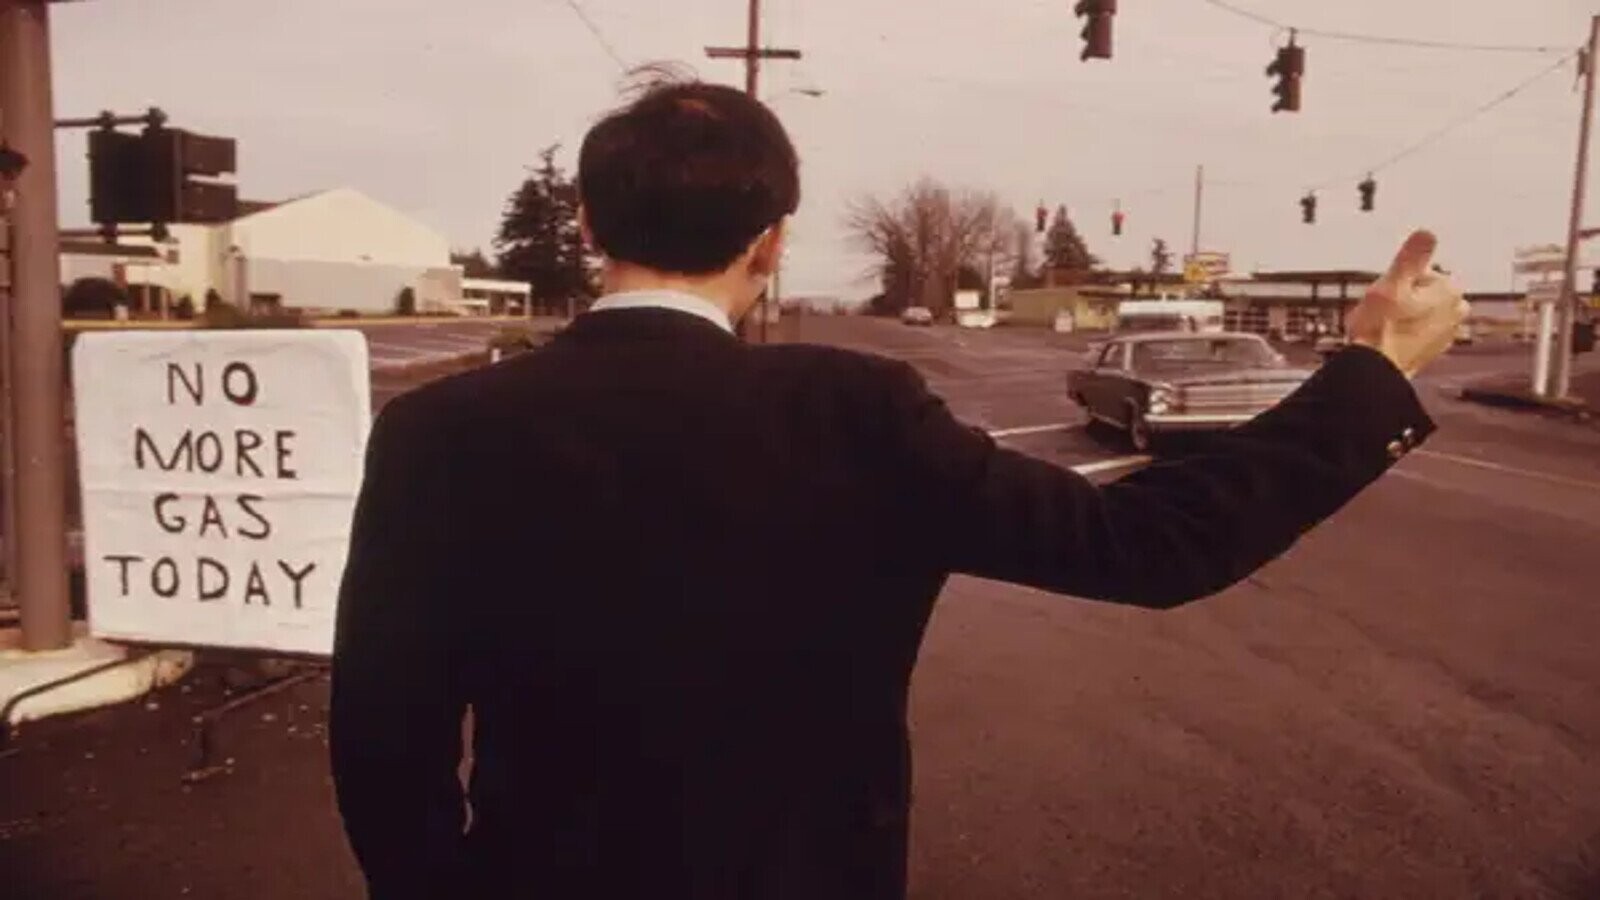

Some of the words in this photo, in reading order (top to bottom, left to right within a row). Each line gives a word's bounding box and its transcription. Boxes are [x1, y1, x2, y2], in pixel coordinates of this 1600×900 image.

[167, 361, 259, 407] NO
[134, 427, 298, 480] MORE
[153, 492, 271, 540] GAS
[103, 555, 316, 608] TODAY
